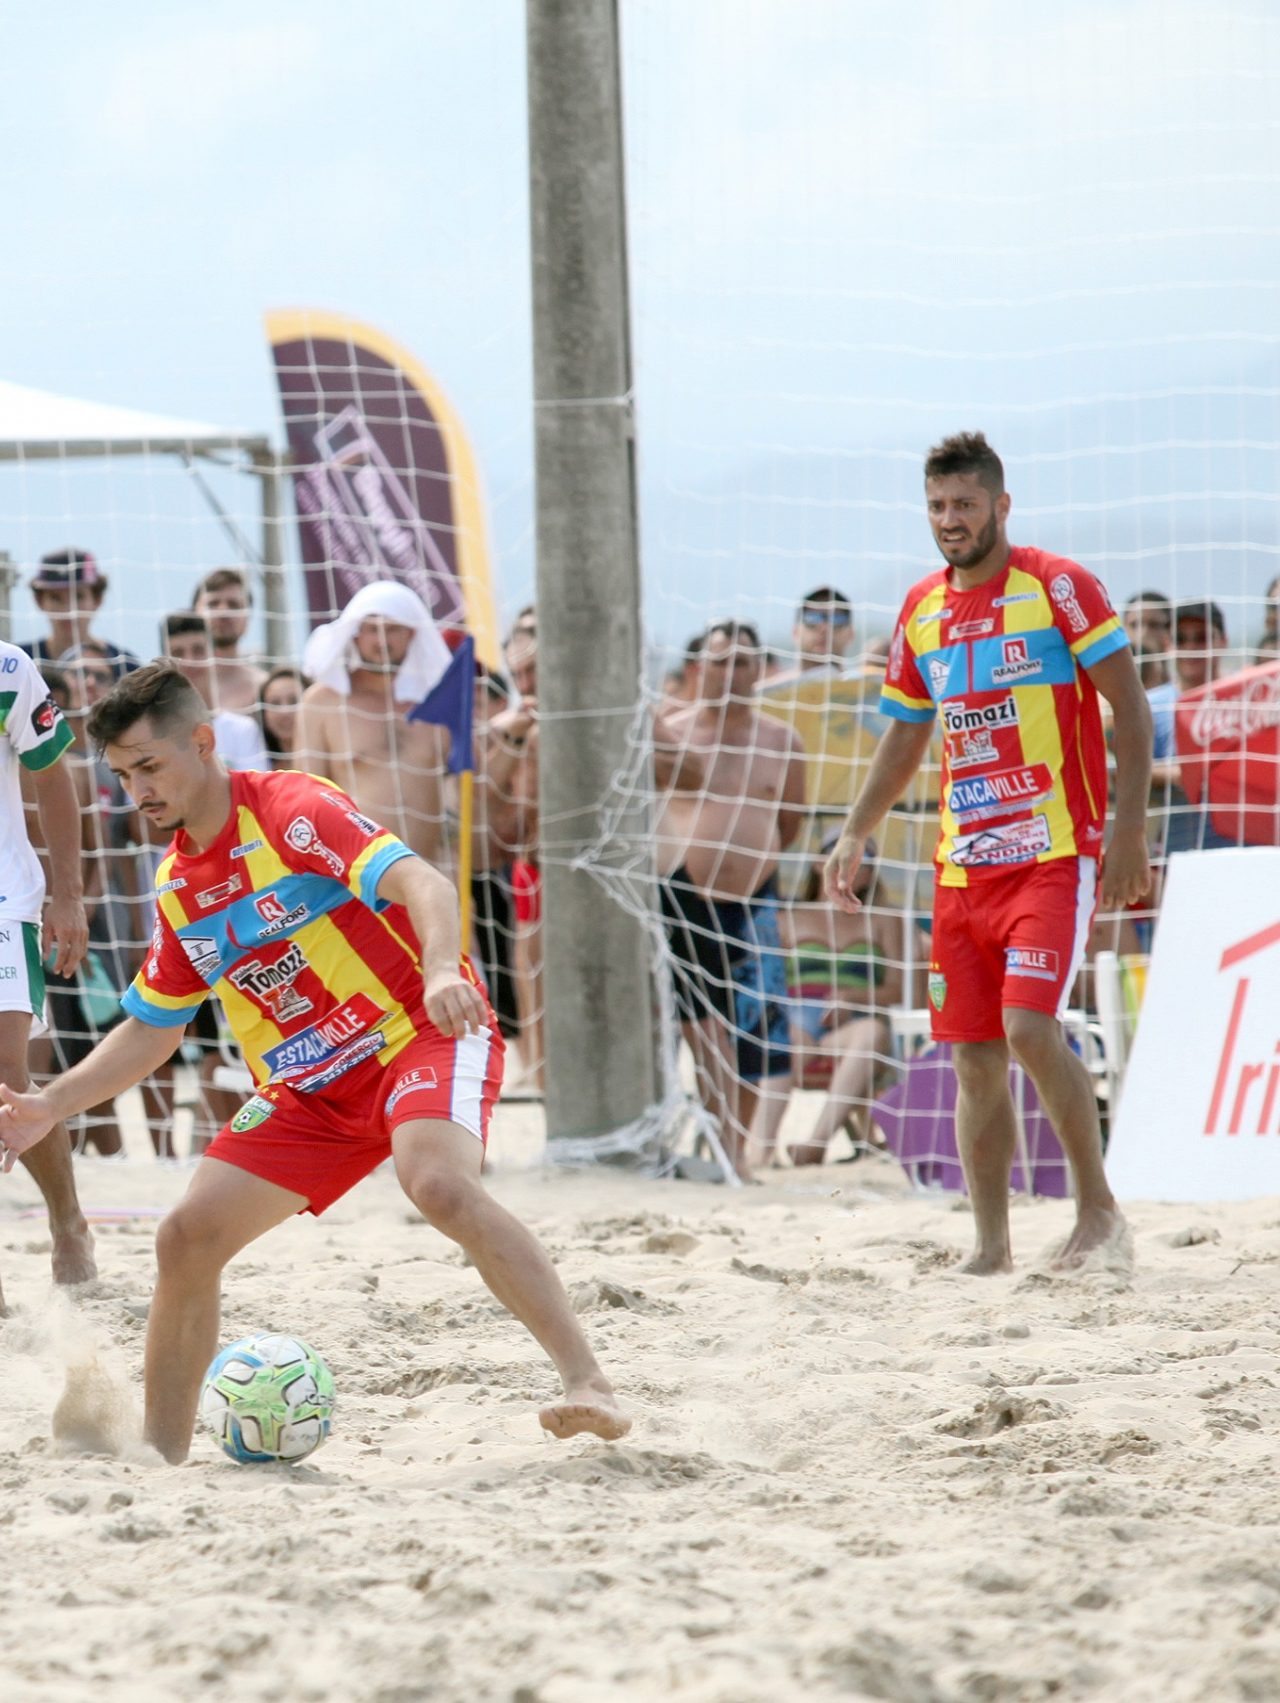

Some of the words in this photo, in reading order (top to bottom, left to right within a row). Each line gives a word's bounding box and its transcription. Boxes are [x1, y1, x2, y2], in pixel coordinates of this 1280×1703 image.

[1, 657, 19, 674] 10
[239, 944, 308, 995] Tomazi
[275, 1006, 367, 1070] ESTACAVILLE
